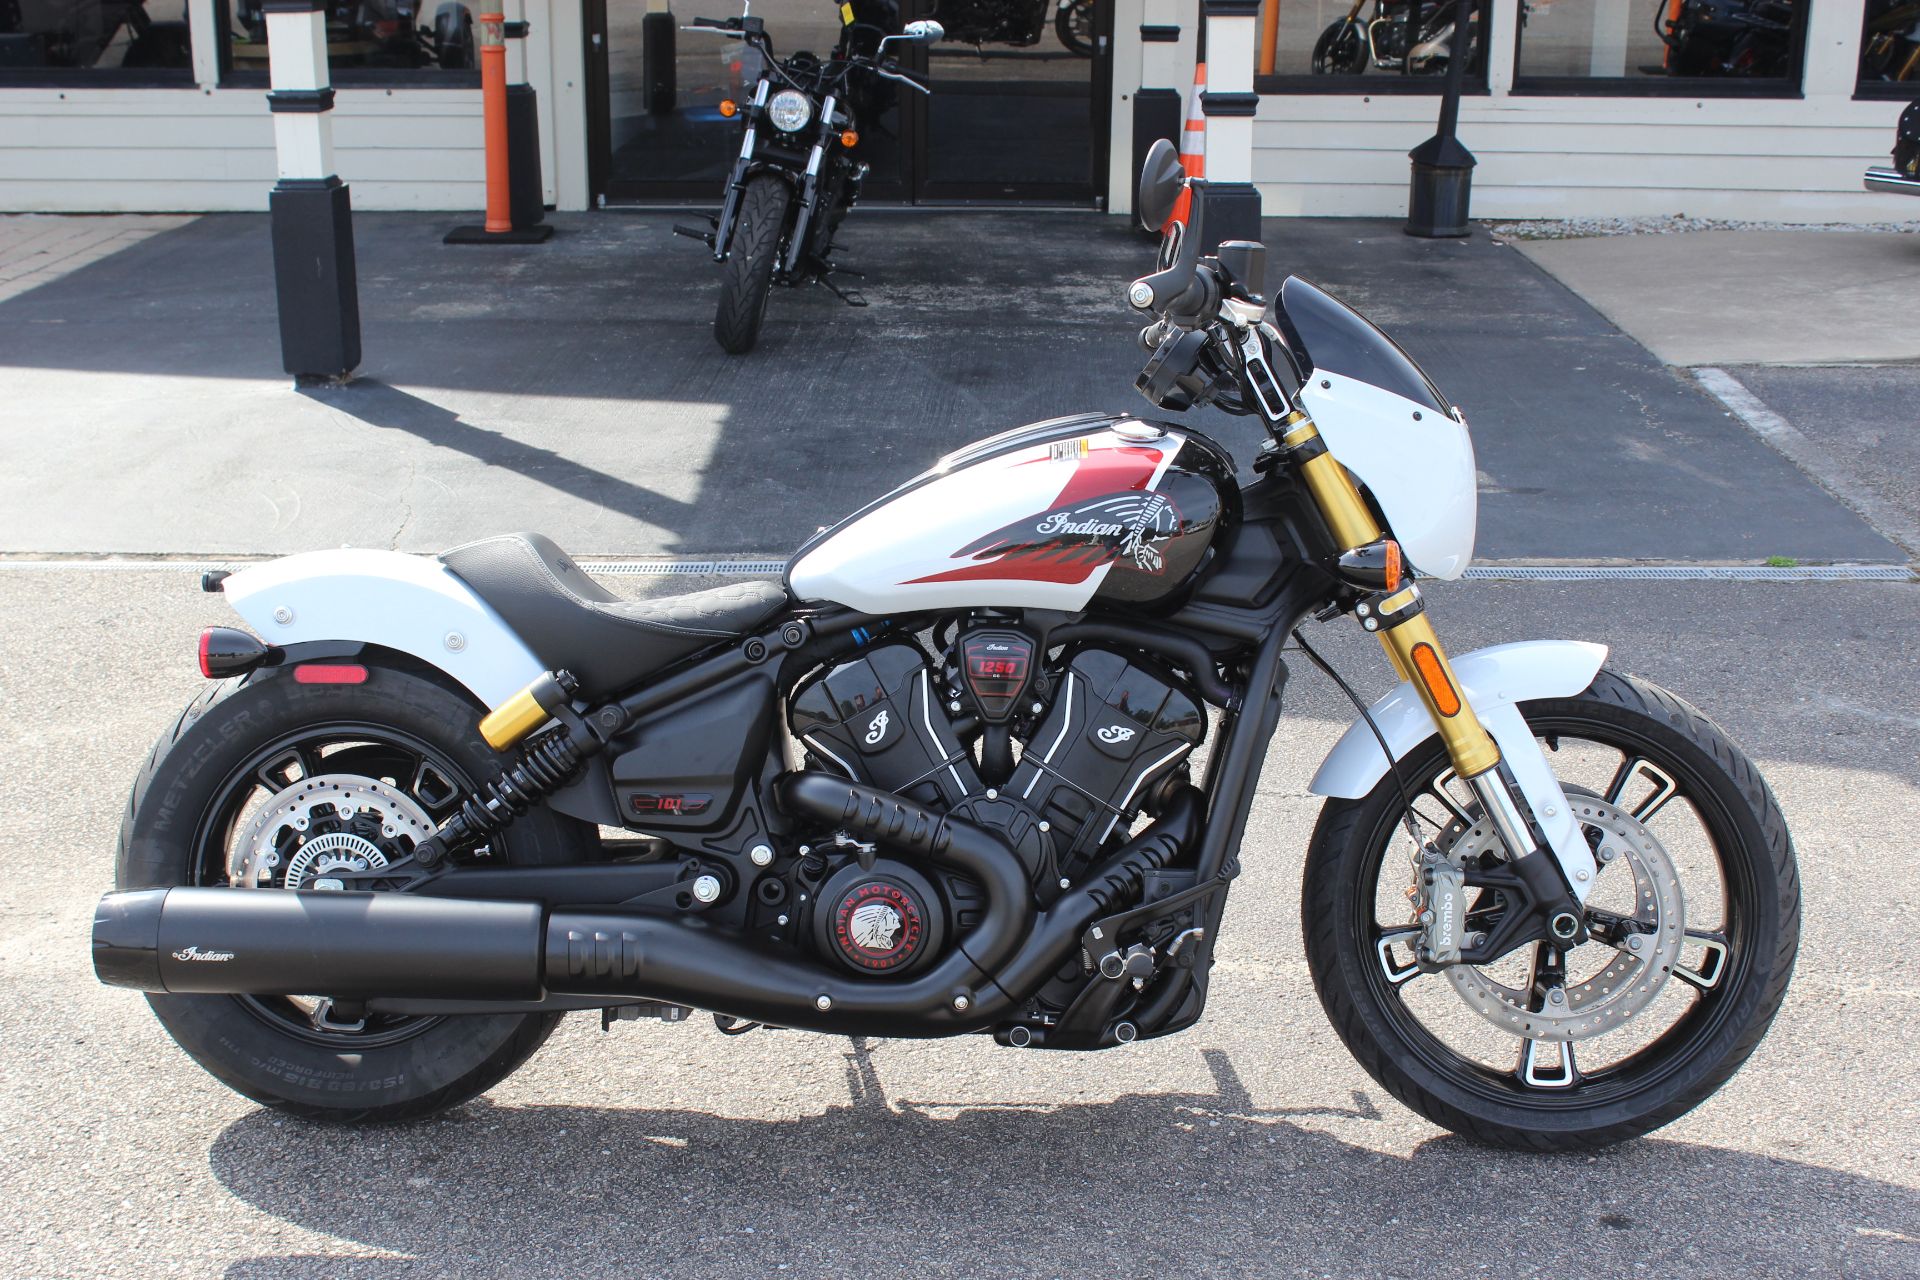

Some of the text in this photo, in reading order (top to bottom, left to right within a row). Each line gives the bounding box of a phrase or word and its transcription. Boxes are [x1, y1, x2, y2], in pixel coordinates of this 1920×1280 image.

[1036, 512, 1123, 536] Indian
[986, 643, 1009, 651] Indian
[979, 661, 1016, 674] 1250
[153, 709, 260, 832] METZELER
[657, 798, 682, 811] 101
[837, 885, 920, 952] INDIAN MOTORCYCLE
[1439, 892, 1453, 946] brembo
[177, 946, 229, 962] Indian
[864, 958, 896, 969] 1901
[267, 1055, 354, 1080] REINFORCED
